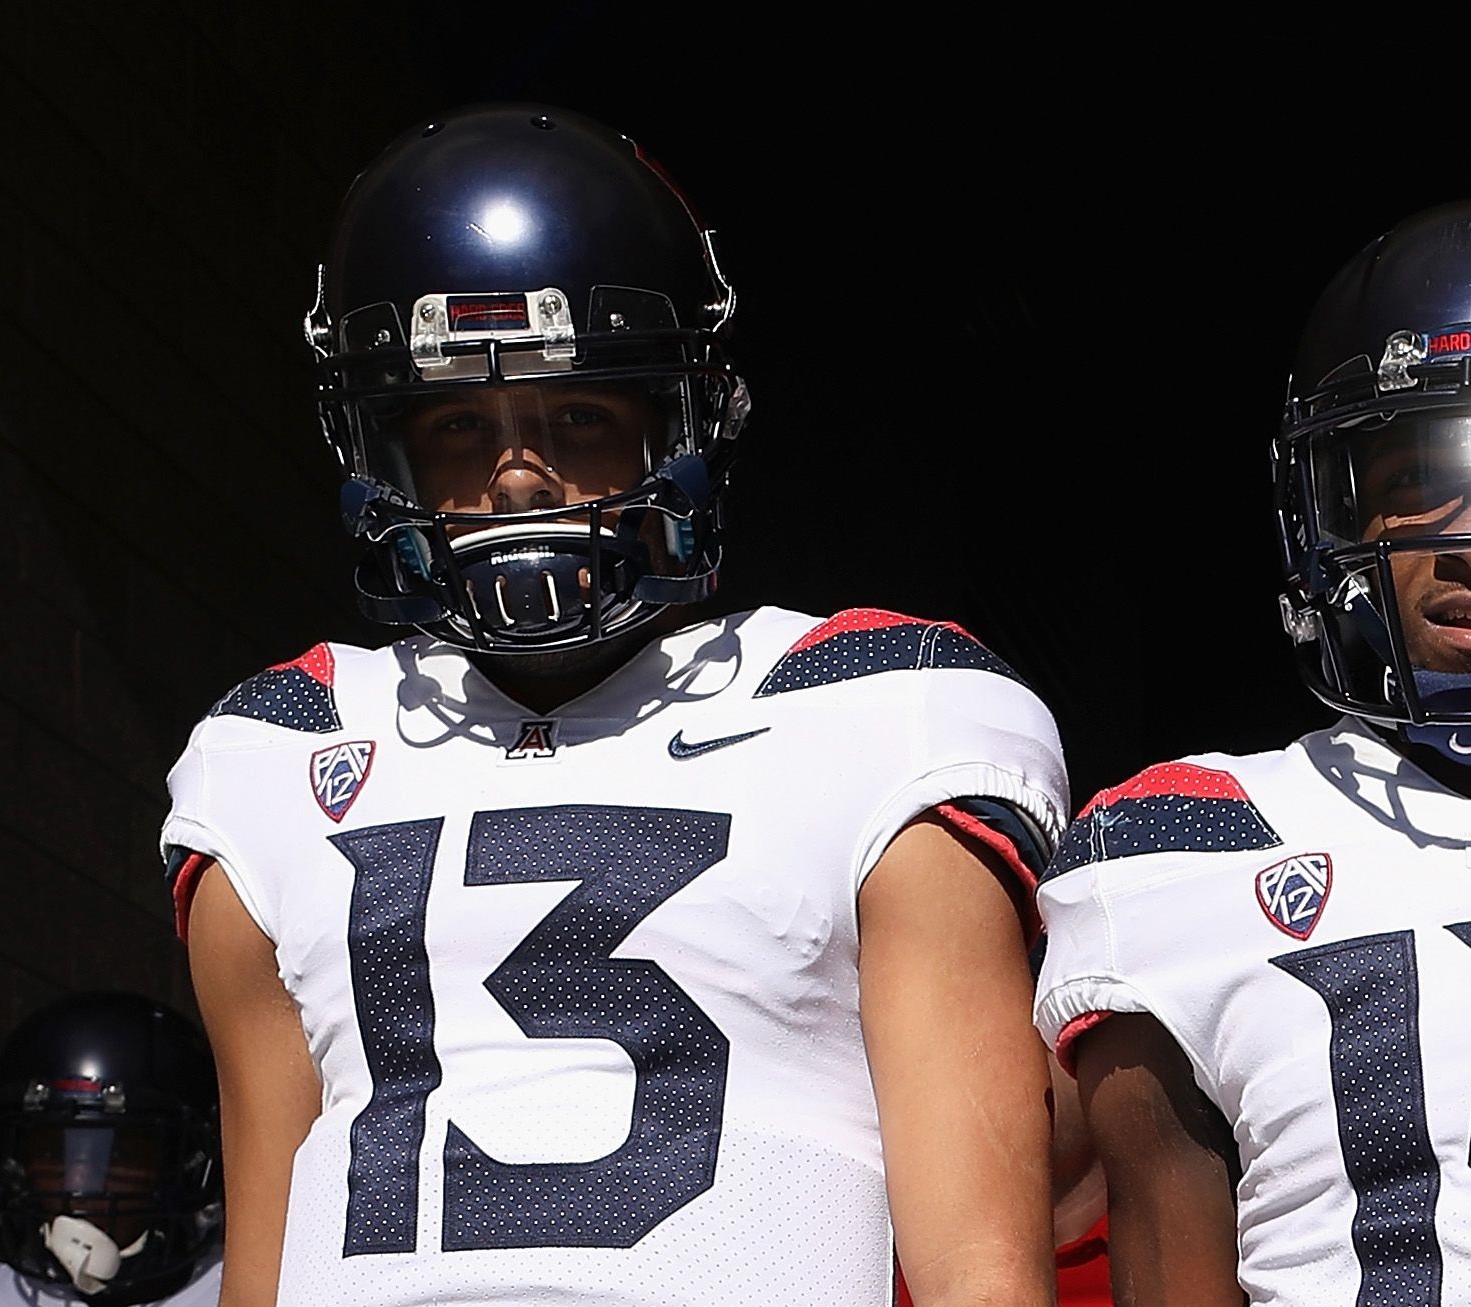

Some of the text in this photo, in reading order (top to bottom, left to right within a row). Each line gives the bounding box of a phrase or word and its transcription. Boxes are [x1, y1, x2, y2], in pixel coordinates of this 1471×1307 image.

[1429, 331, 1470, 354] HARD
[505, 720, 558, 760] A
[313, 743, 373, 796] PAC
[326, 772, 355, 807] 12
[1259, 853, 1327, 914] PAC
[1280, 887, 1318, 925] 12
[327, 804, 732, 1258] 13
